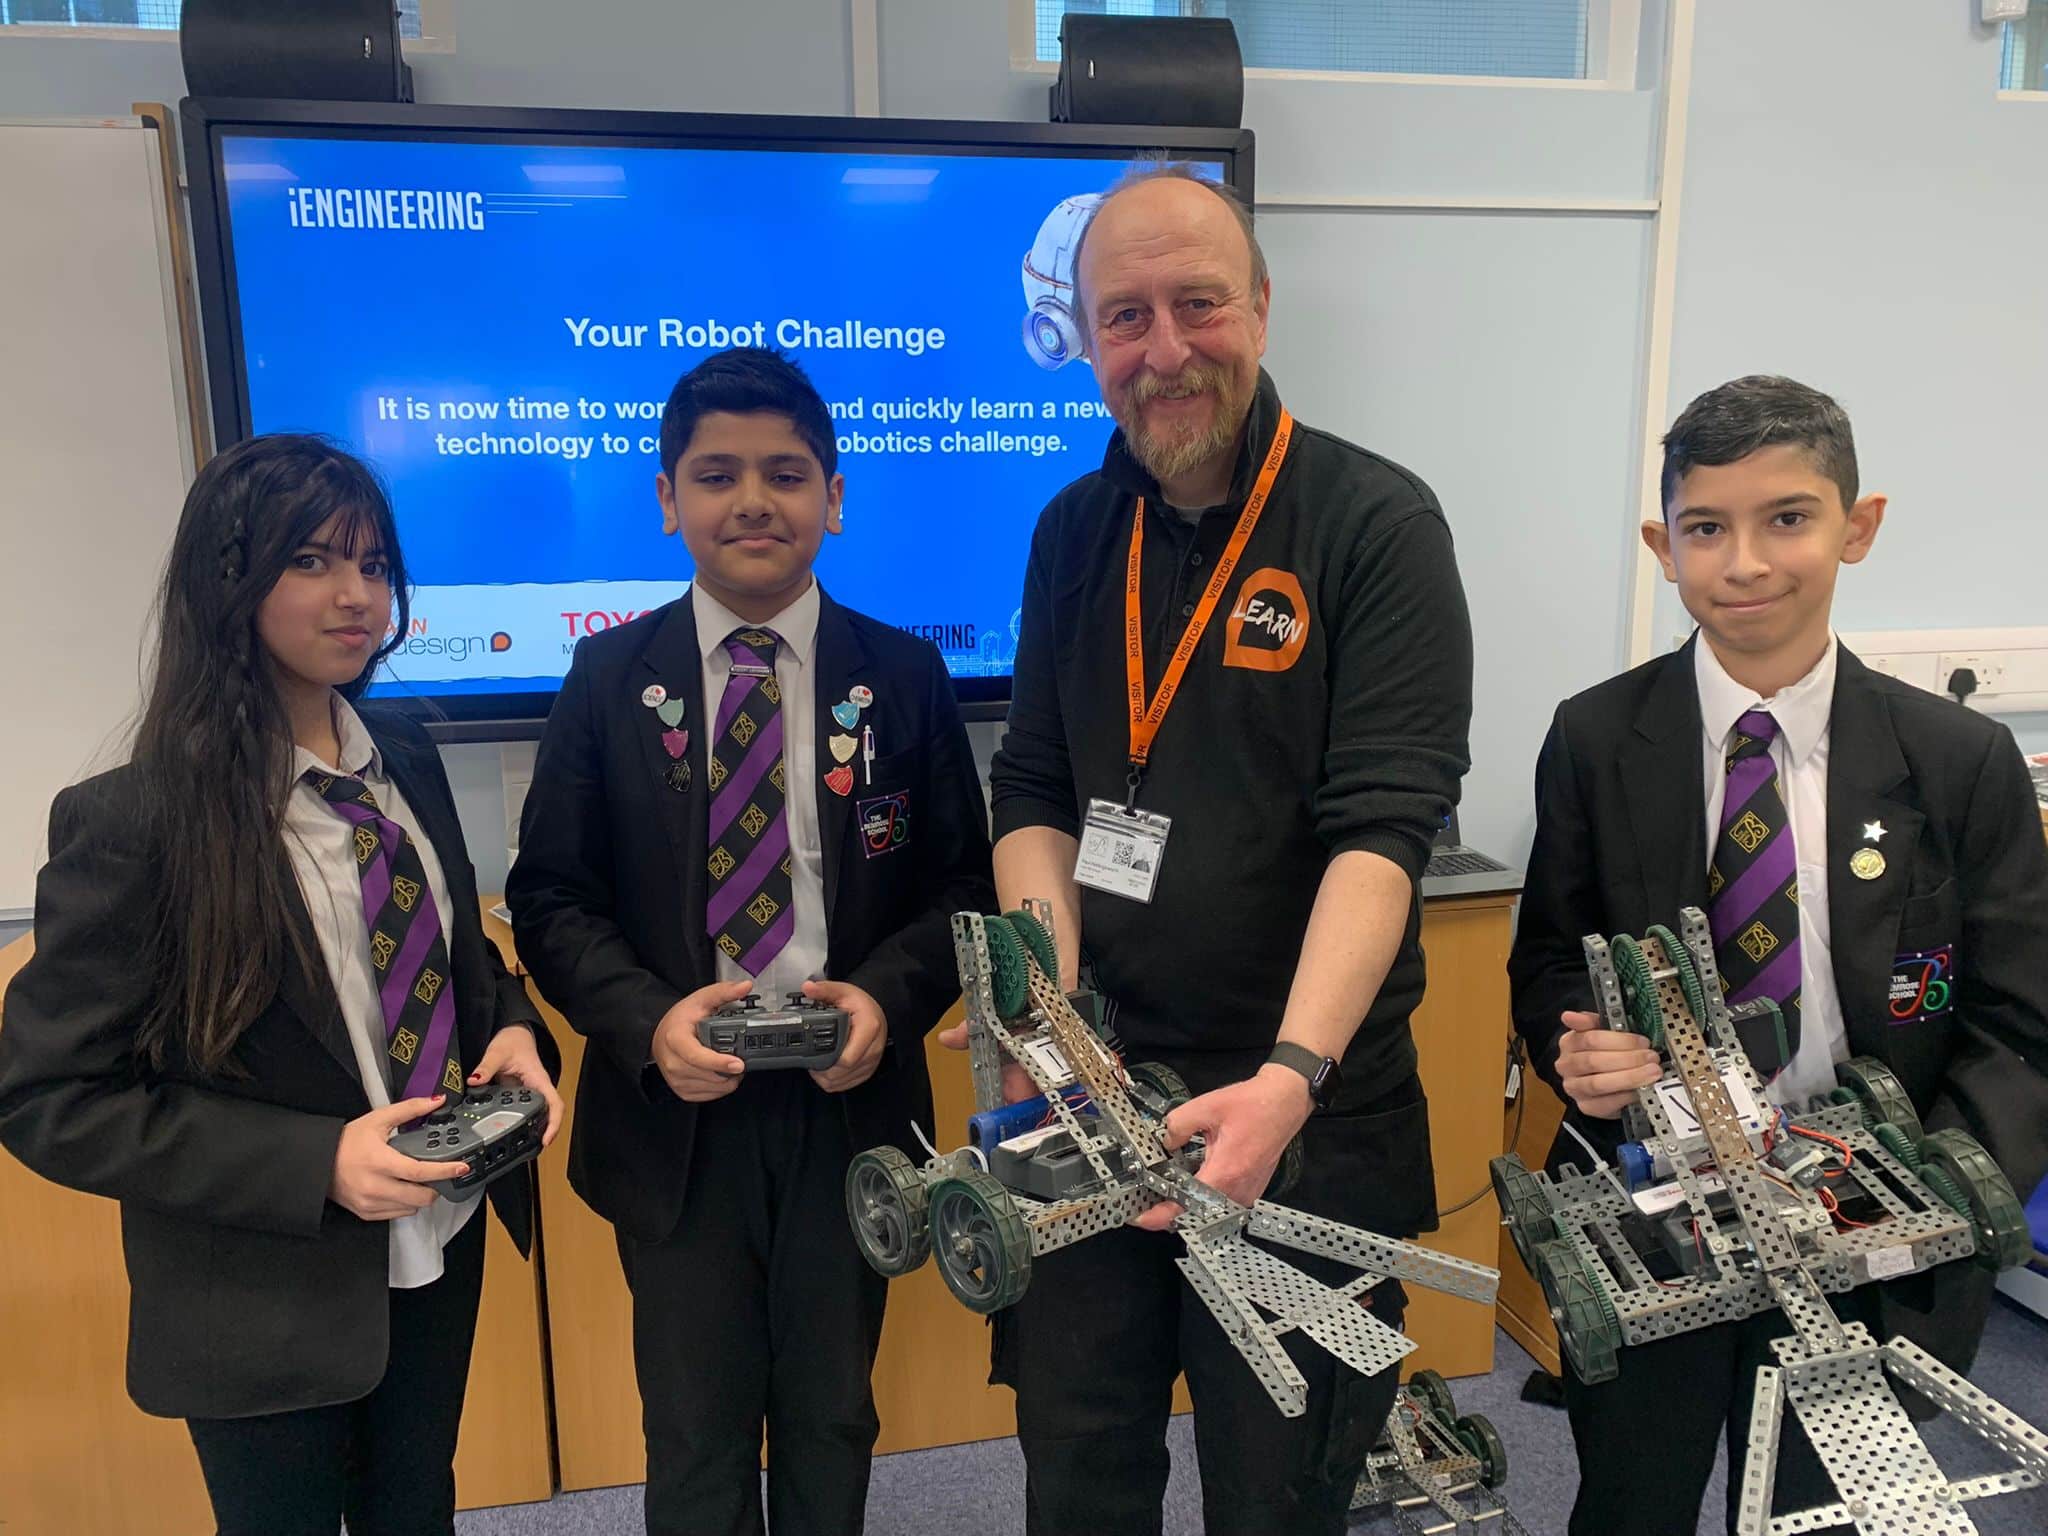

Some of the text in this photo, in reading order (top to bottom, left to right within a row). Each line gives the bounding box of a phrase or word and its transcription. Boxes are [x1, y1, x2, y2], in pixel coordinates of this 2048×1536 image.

[289, 188, 484, 230] iENGINEERING
[564, 317, 945, 356] Your Robot Challenge
[378, 397, 399, 421] It
[407, 397, 430, 420] is
[440, 402, 499, 420] now
[508, 397, 570, 420] time
[578, 398, 606, 419] to
[615, 402, 665, 419] wor
[872, 397, 963, 424] quickly
[971, 397, 1034, 419] learn
[1041, 402, 1056, 419] a
[1064, 401, 1112, 418] new
[436, 431, 594, 459] technology
[602, 432, 630, 454] to
[835, 431, 1067, 457] obotics challenge.
[1267, 432, 1289, 471] VISITOR
[1239, 492, 1265, 535] VISITOR
[1127, 552, 1138, 593] VISITOR
[1207, 558, 1234, 599] VISITOR
[560, 609, 654, 637] TOY
[1128, 616, 1139, 658] VISITOR
[1232, 595, 1304, 644] LEARN
[1178, 620, 1204, 662] VISITOR
[1131, 682, 1142, 723] VISITOR
[1149, 683, 1174, 725] VISITOR
